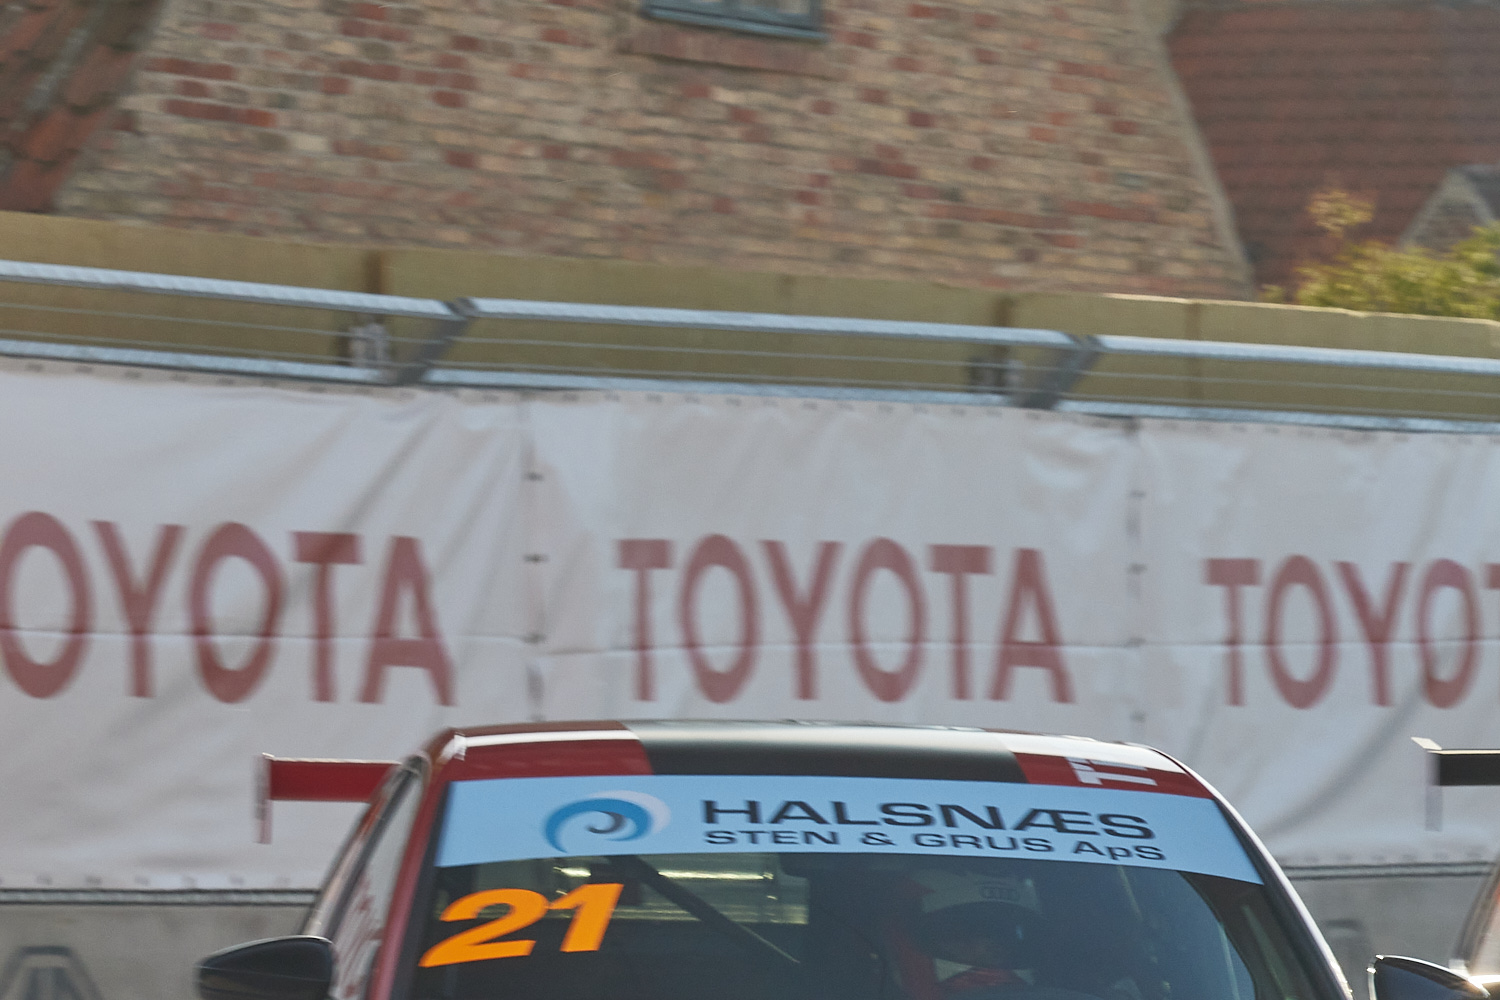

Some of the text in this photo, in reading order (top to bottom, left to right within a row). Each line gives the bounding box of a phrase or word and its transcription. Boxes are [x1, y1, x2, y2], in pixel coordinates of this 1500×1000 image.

[617, 532, 1075, 704] TOYOTA
[704, 799, 1156, 840] HALSNÆS
[704, 829, 1168, 861] STEN & GRUS ApS
[418, 883, 624, 968] 21
